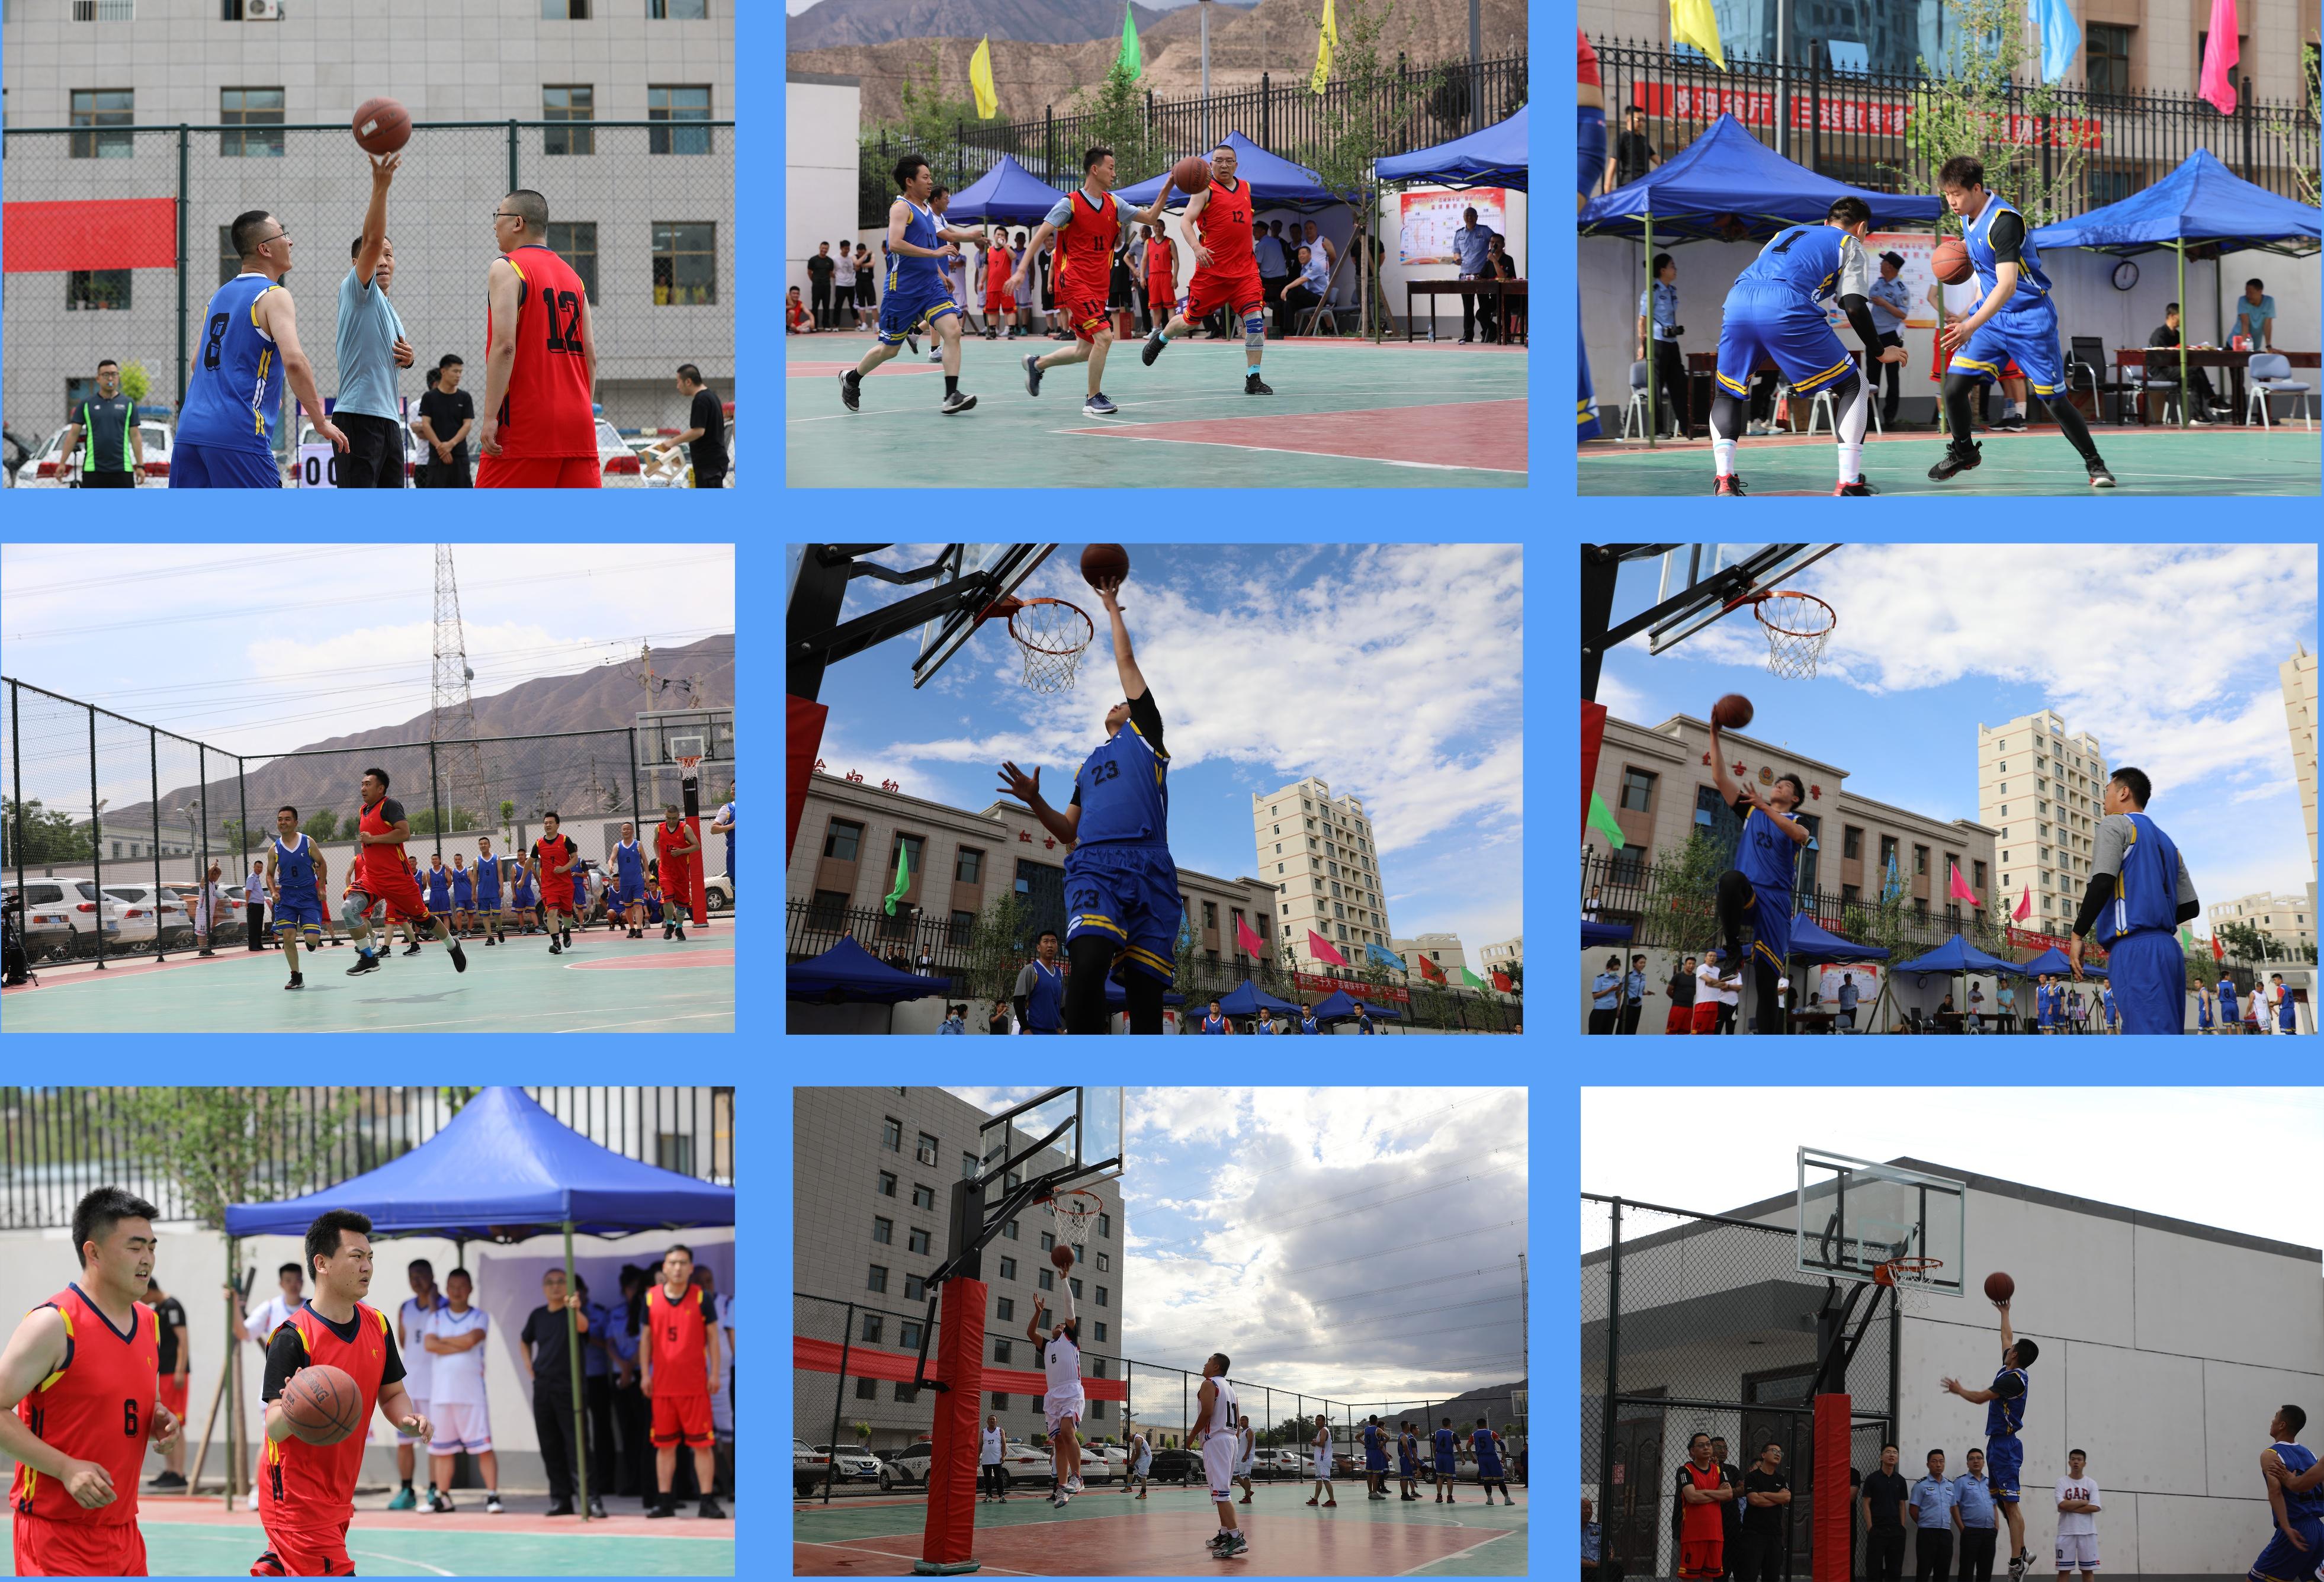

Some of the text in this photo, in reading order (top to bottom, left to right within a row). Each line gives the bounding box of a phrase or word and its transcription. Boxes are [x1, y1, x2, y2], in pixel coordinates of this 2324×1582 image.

[1232, 211, 1245, 224] 12
[927, 233, 936, 248] 11
[1094, 236, 1105, 251] 11
[1771, 230, 1810, 255] 1
[1083, 299, 1099, 316] 11
[543, 288, 585, 357] 12
[204, 313, 230, 371] 8
[1091, 760, 1120, 787] 23
[1810, 784, 1822, 800] 警
[1019, 830, 1055, 849] 红古
[1756, 832, 1773, 849] 23
[550, 856, 554, 864] 7
[291, 865, 298, 877] 6
[1071, 889, 1100, 913] 23
[2223, 988, 2230, 999] 8
[668, 1326, 678, 1342] 5
[1051, 1353, 1057, 1364] 6
[124, 1398, 139, 1438] 6
[1366, 1434, 1372, 1445] 8
[1440, 1437, 1446, 1448] 4
[1478, 1437, 1487, 1449] 5
[911, 1461, 922, 1469] 公安
